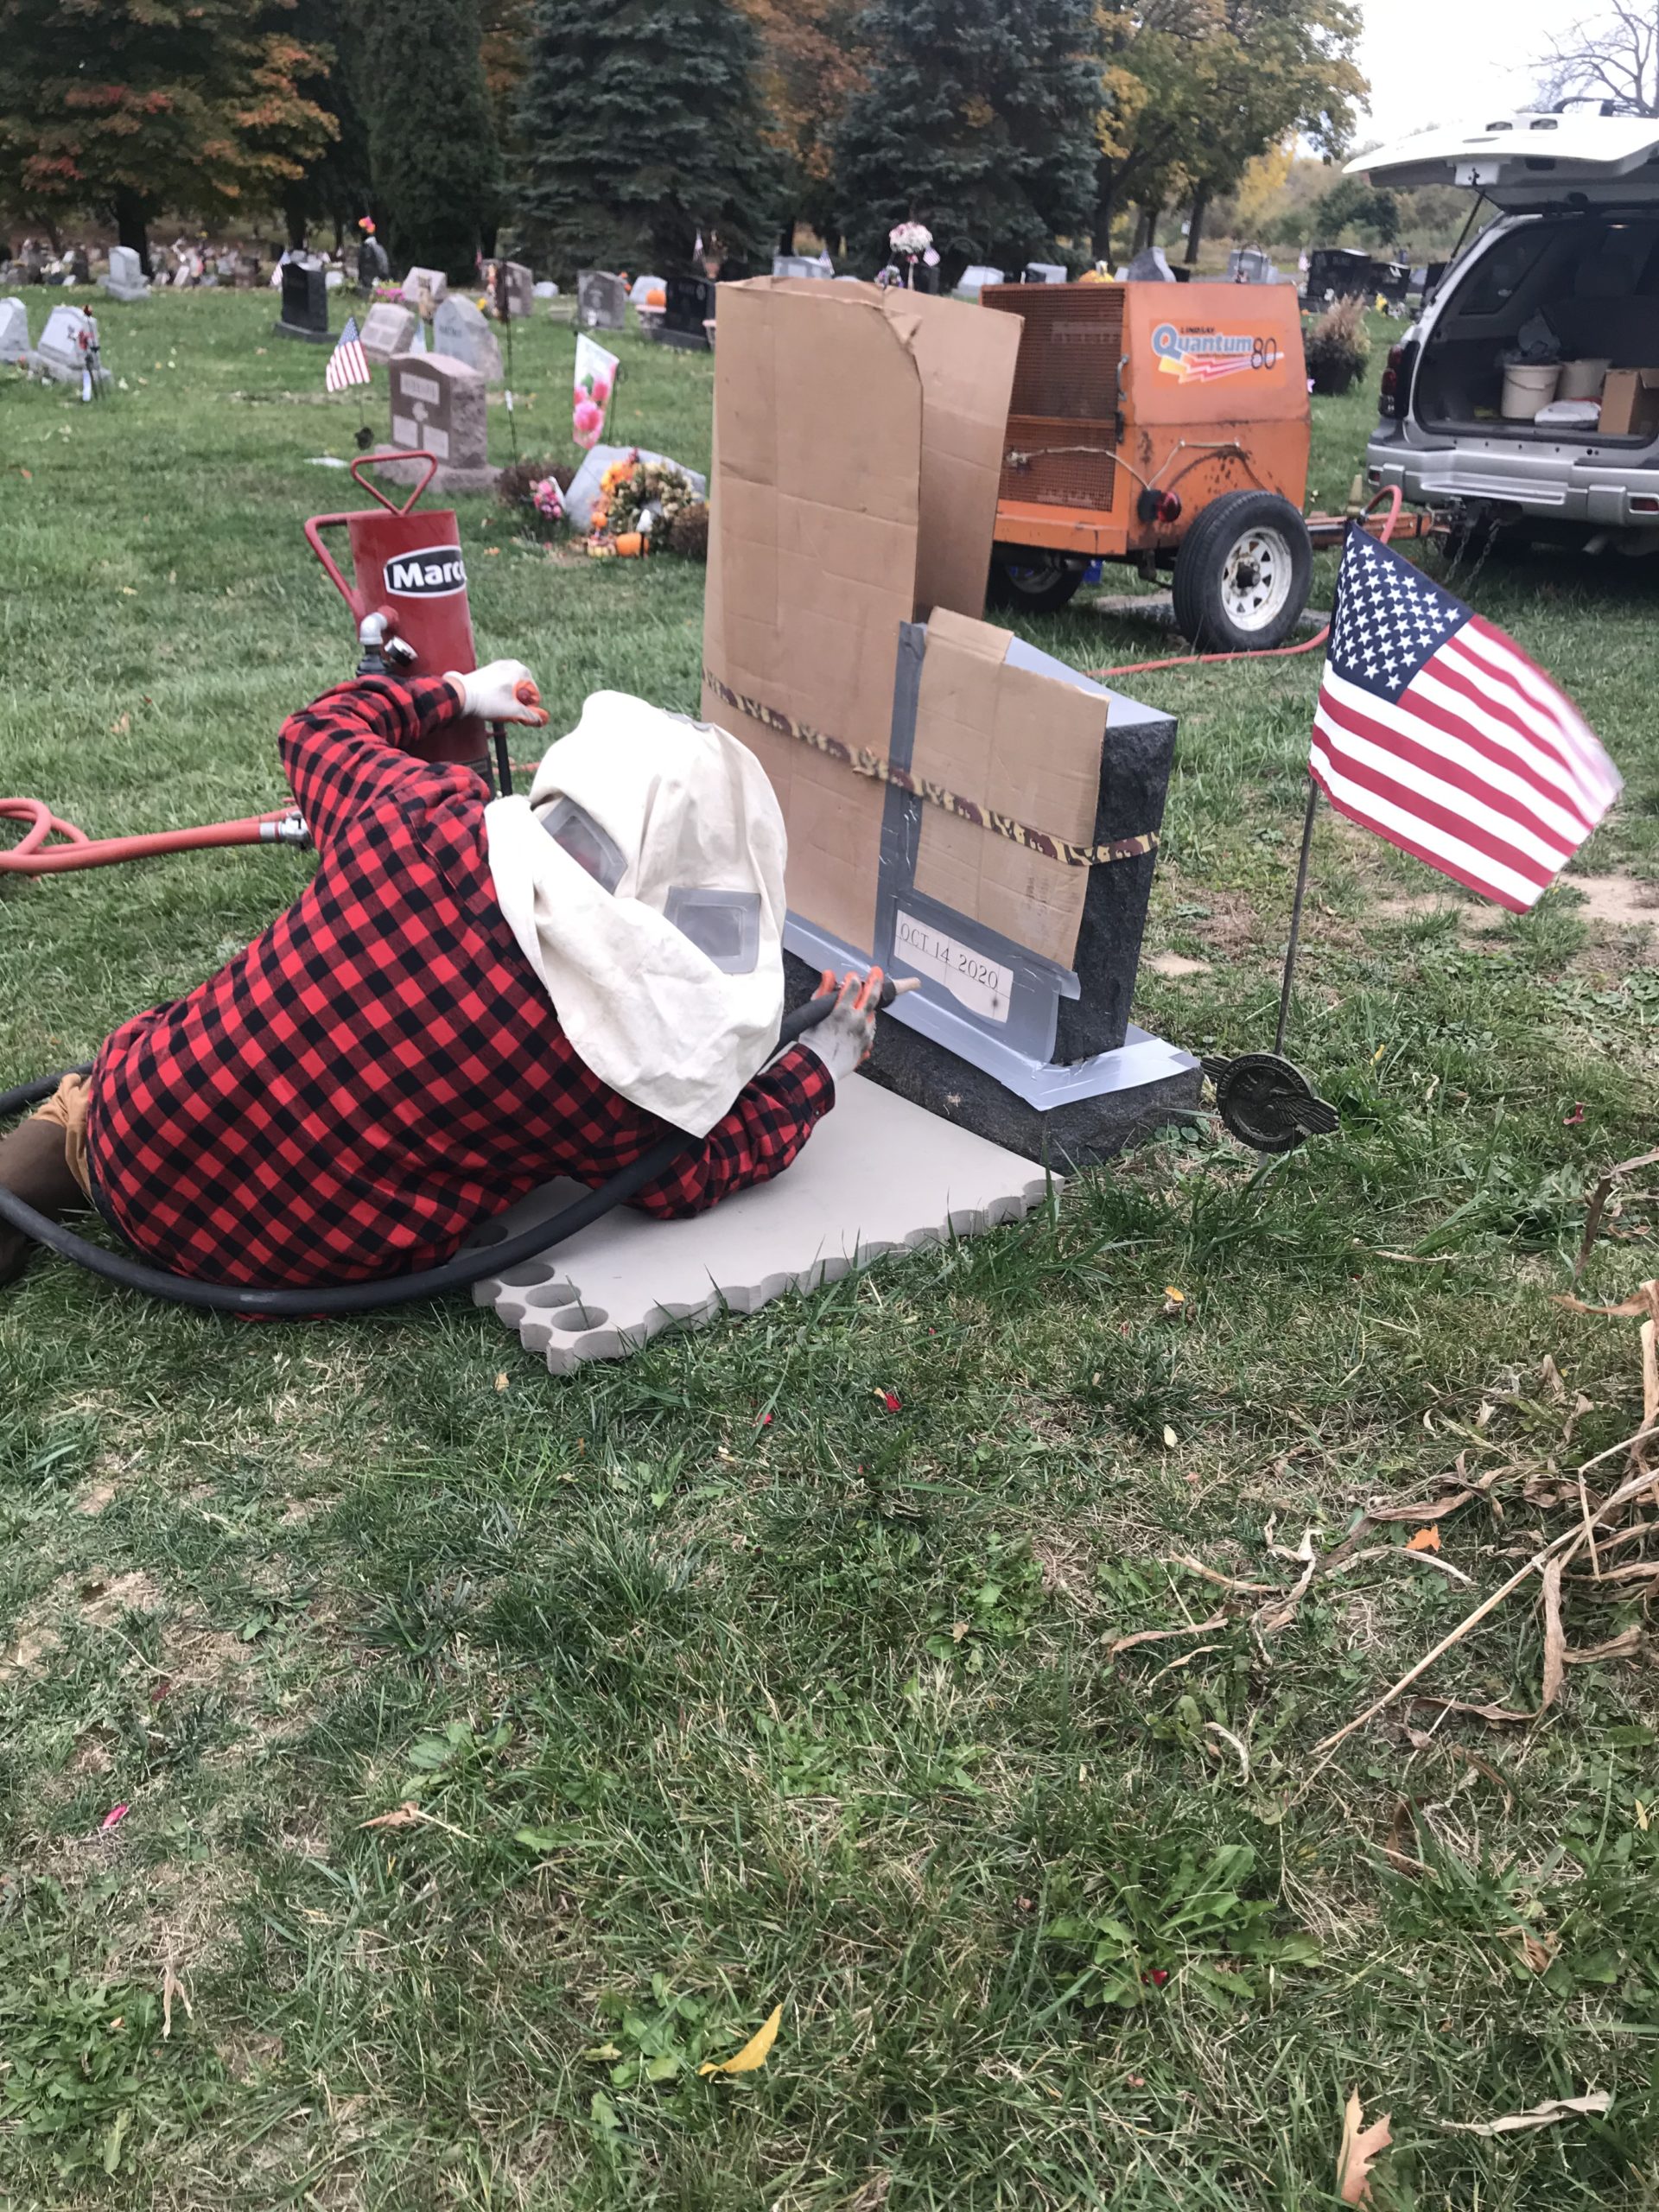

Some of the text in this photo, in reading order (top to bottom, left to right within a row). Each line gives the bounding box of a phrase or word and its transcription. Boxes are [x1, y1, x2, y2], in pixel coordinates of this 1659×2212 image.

[1152, 324, 1253, 361] Quantum
[1251, 336, 1277, 370] 80
[934, 941, 950, 963] 14
[957, 953, 999, 990] 2020
